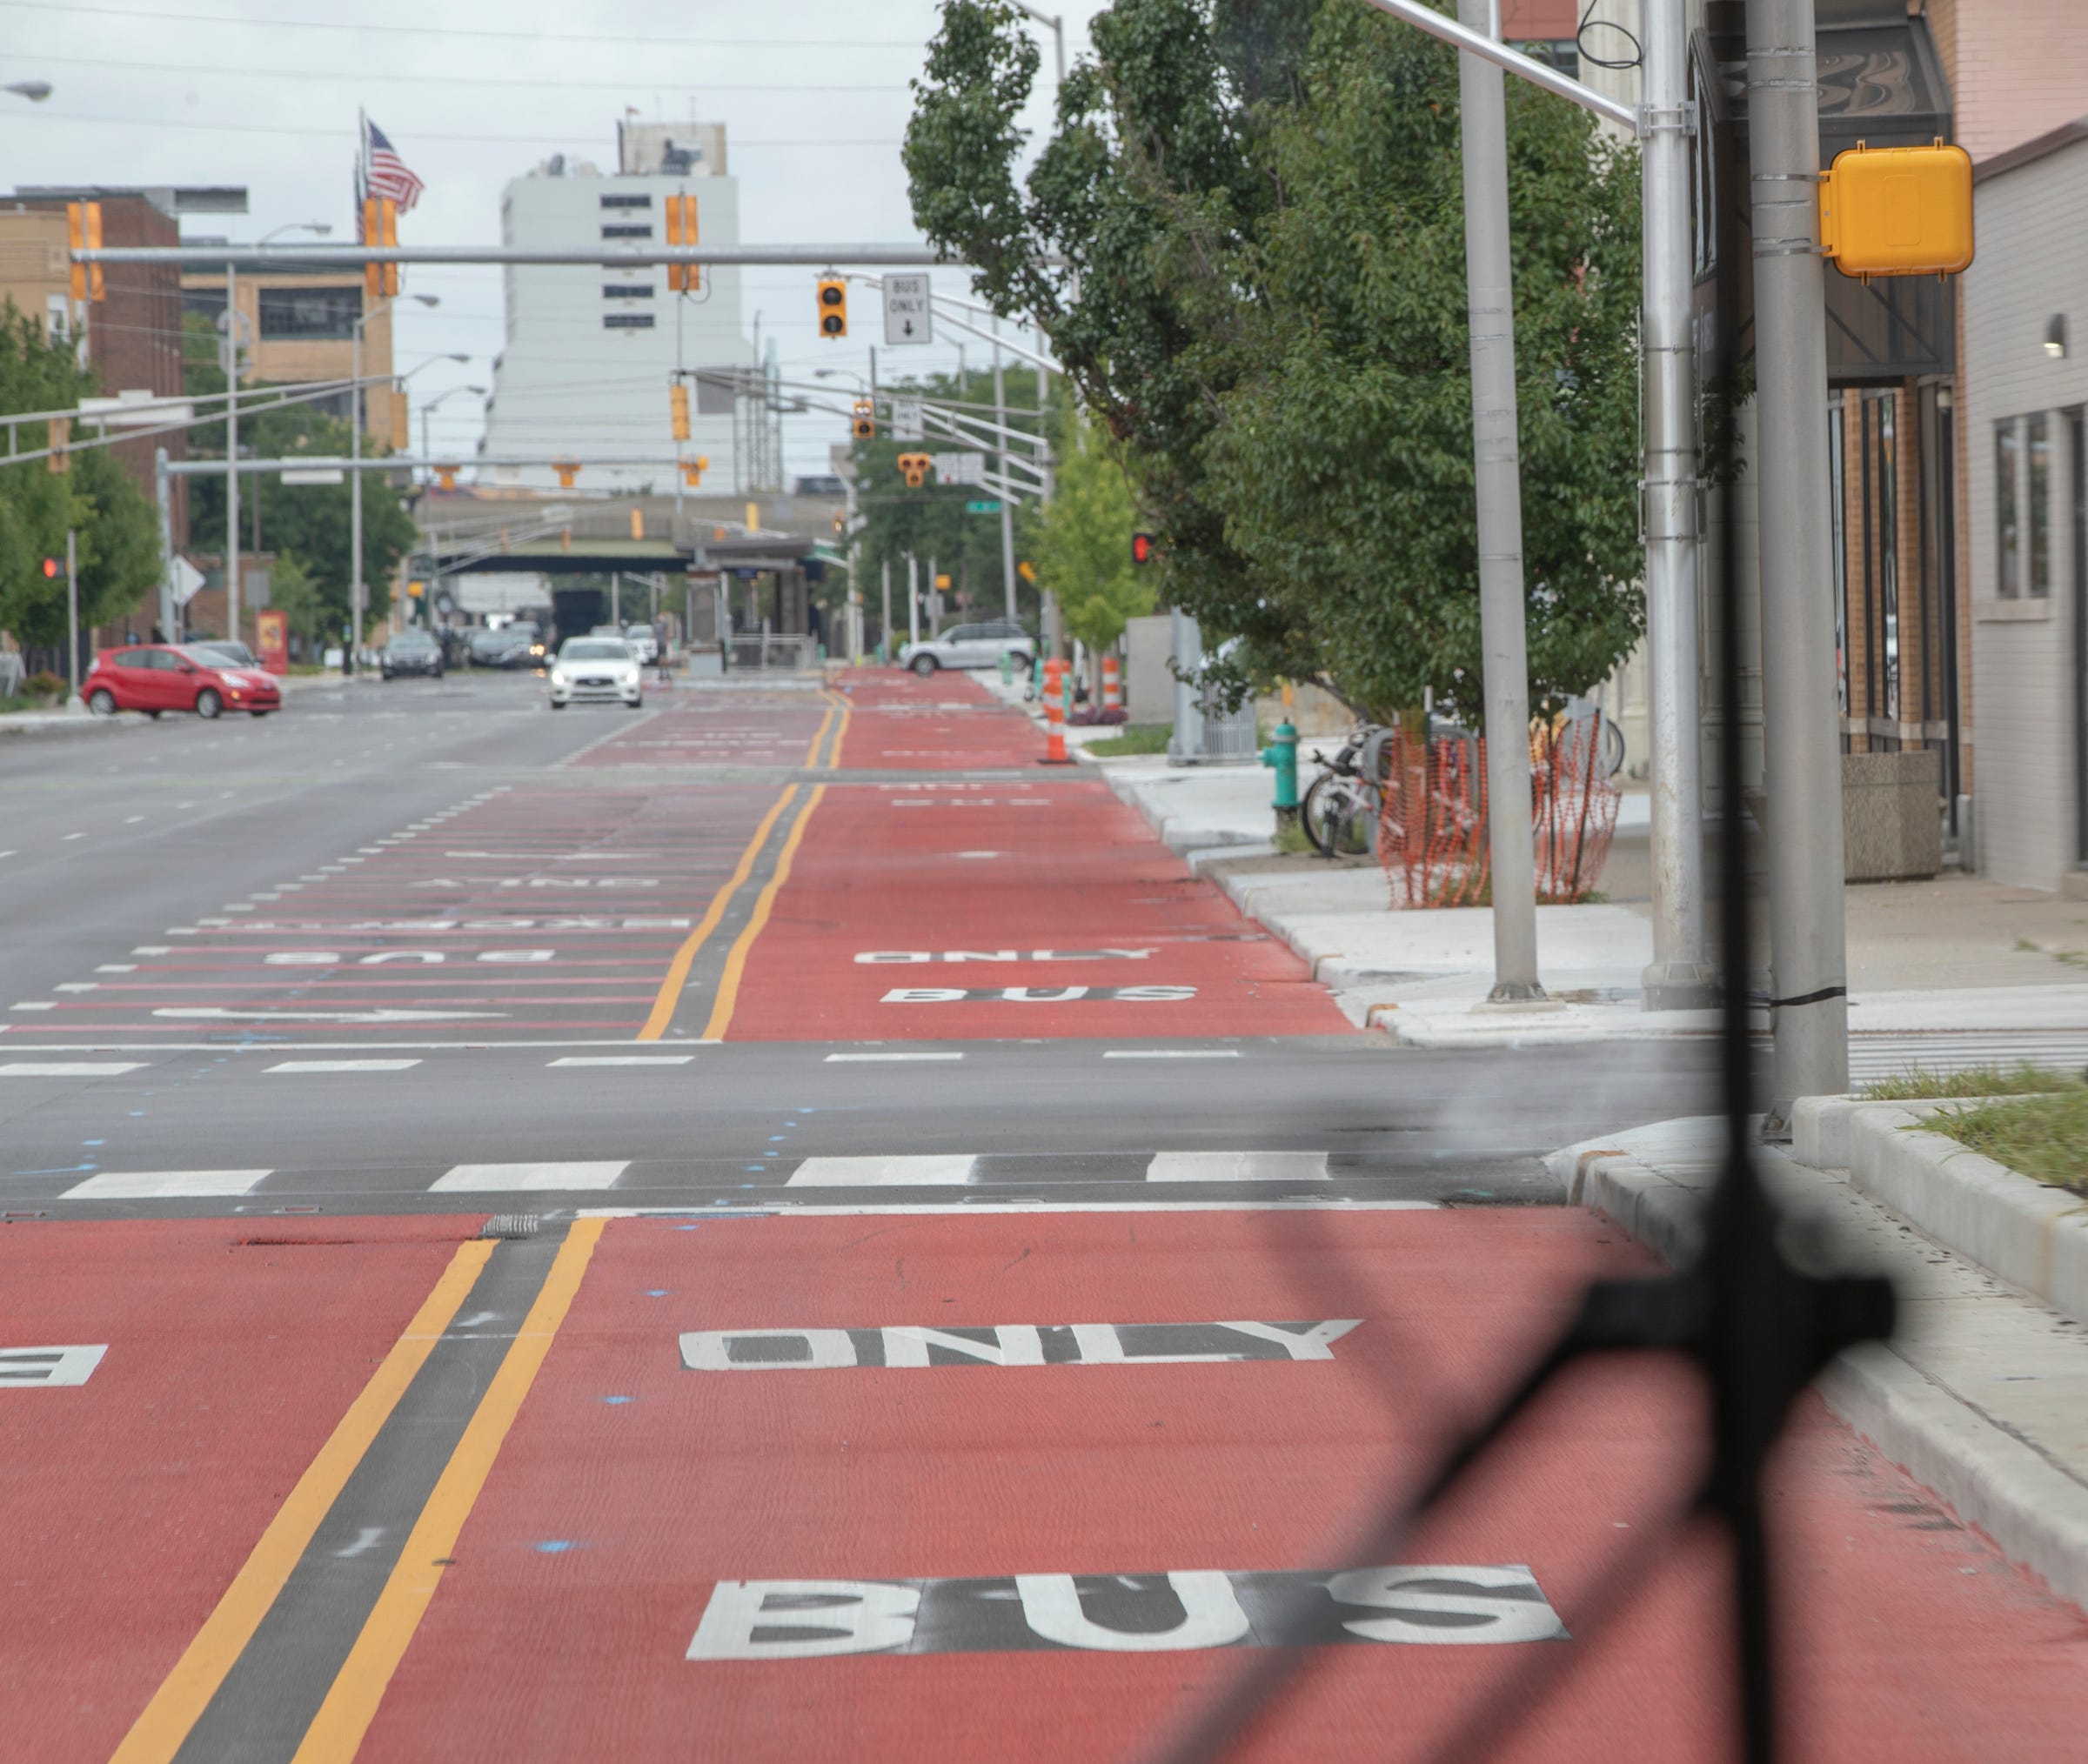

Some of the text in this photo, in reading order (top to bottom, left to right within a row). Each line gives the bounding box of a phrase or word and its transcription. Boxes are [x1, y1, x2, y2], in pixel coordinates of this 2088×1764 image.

[892, 279, 920, 294] BUS
[889, 298, 925, 314] ONLY
[853, 947, 1161, 963] ONLY
[880, 986, 1197, 1002] BUS
[679, 1319, 1366, 1370] ONLY
[686, 1565, 1563, 1660] BUS
